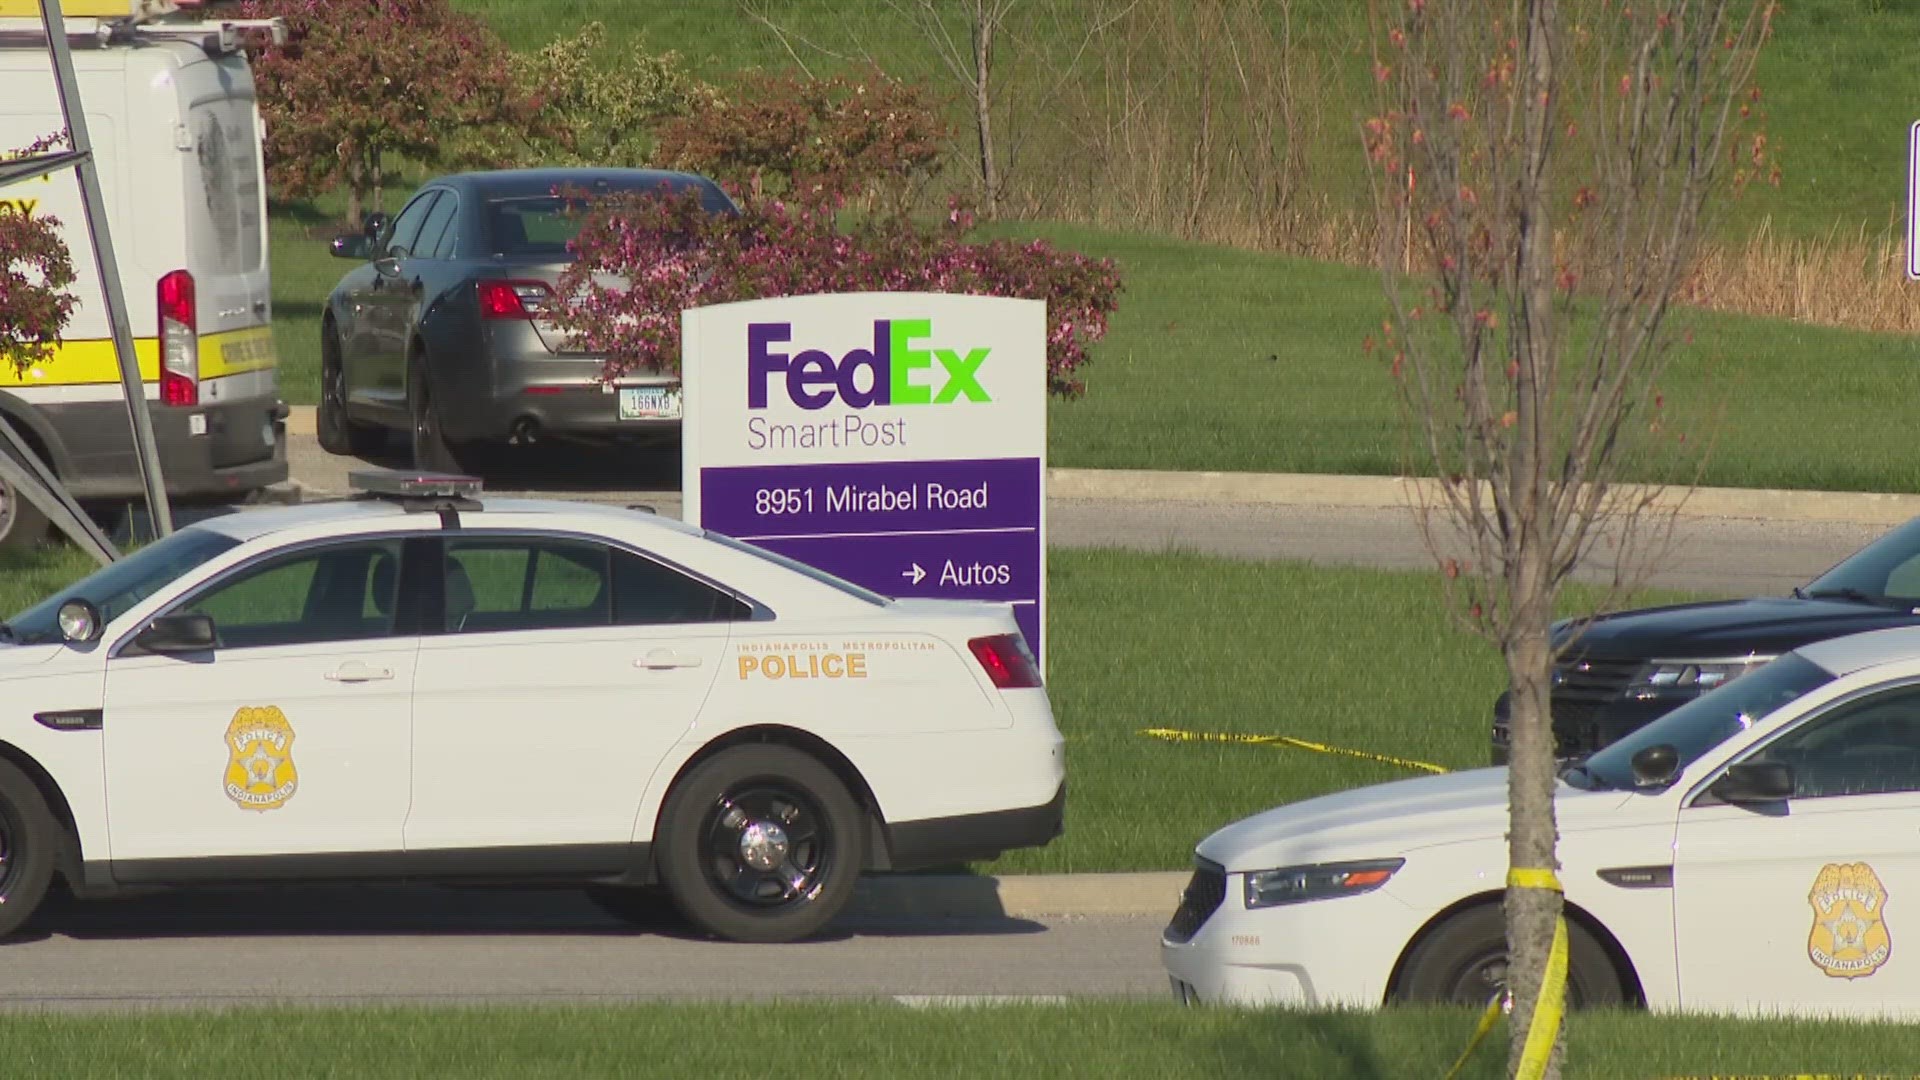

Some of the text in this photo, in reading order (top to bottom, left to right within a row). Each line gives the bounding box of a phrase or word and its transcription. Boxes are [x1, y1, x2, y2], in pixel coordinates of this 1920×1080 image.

[748, 319, 993, 410] FedEx
[748, 415, 906, 449] SmartPost
[755, 481, 988, 514] 8951 Mirabel Road
[939, 559, 1010, 585] Autos
[737, 641, 935, 652] INDIANAPOLIS METROPOLITAN
[738, 653, 867, 680] POLICE
[228, 783, 293, 803] INDIANAPOLIS
[1813, 947, 1887, 970] INDIANAPOLIS
